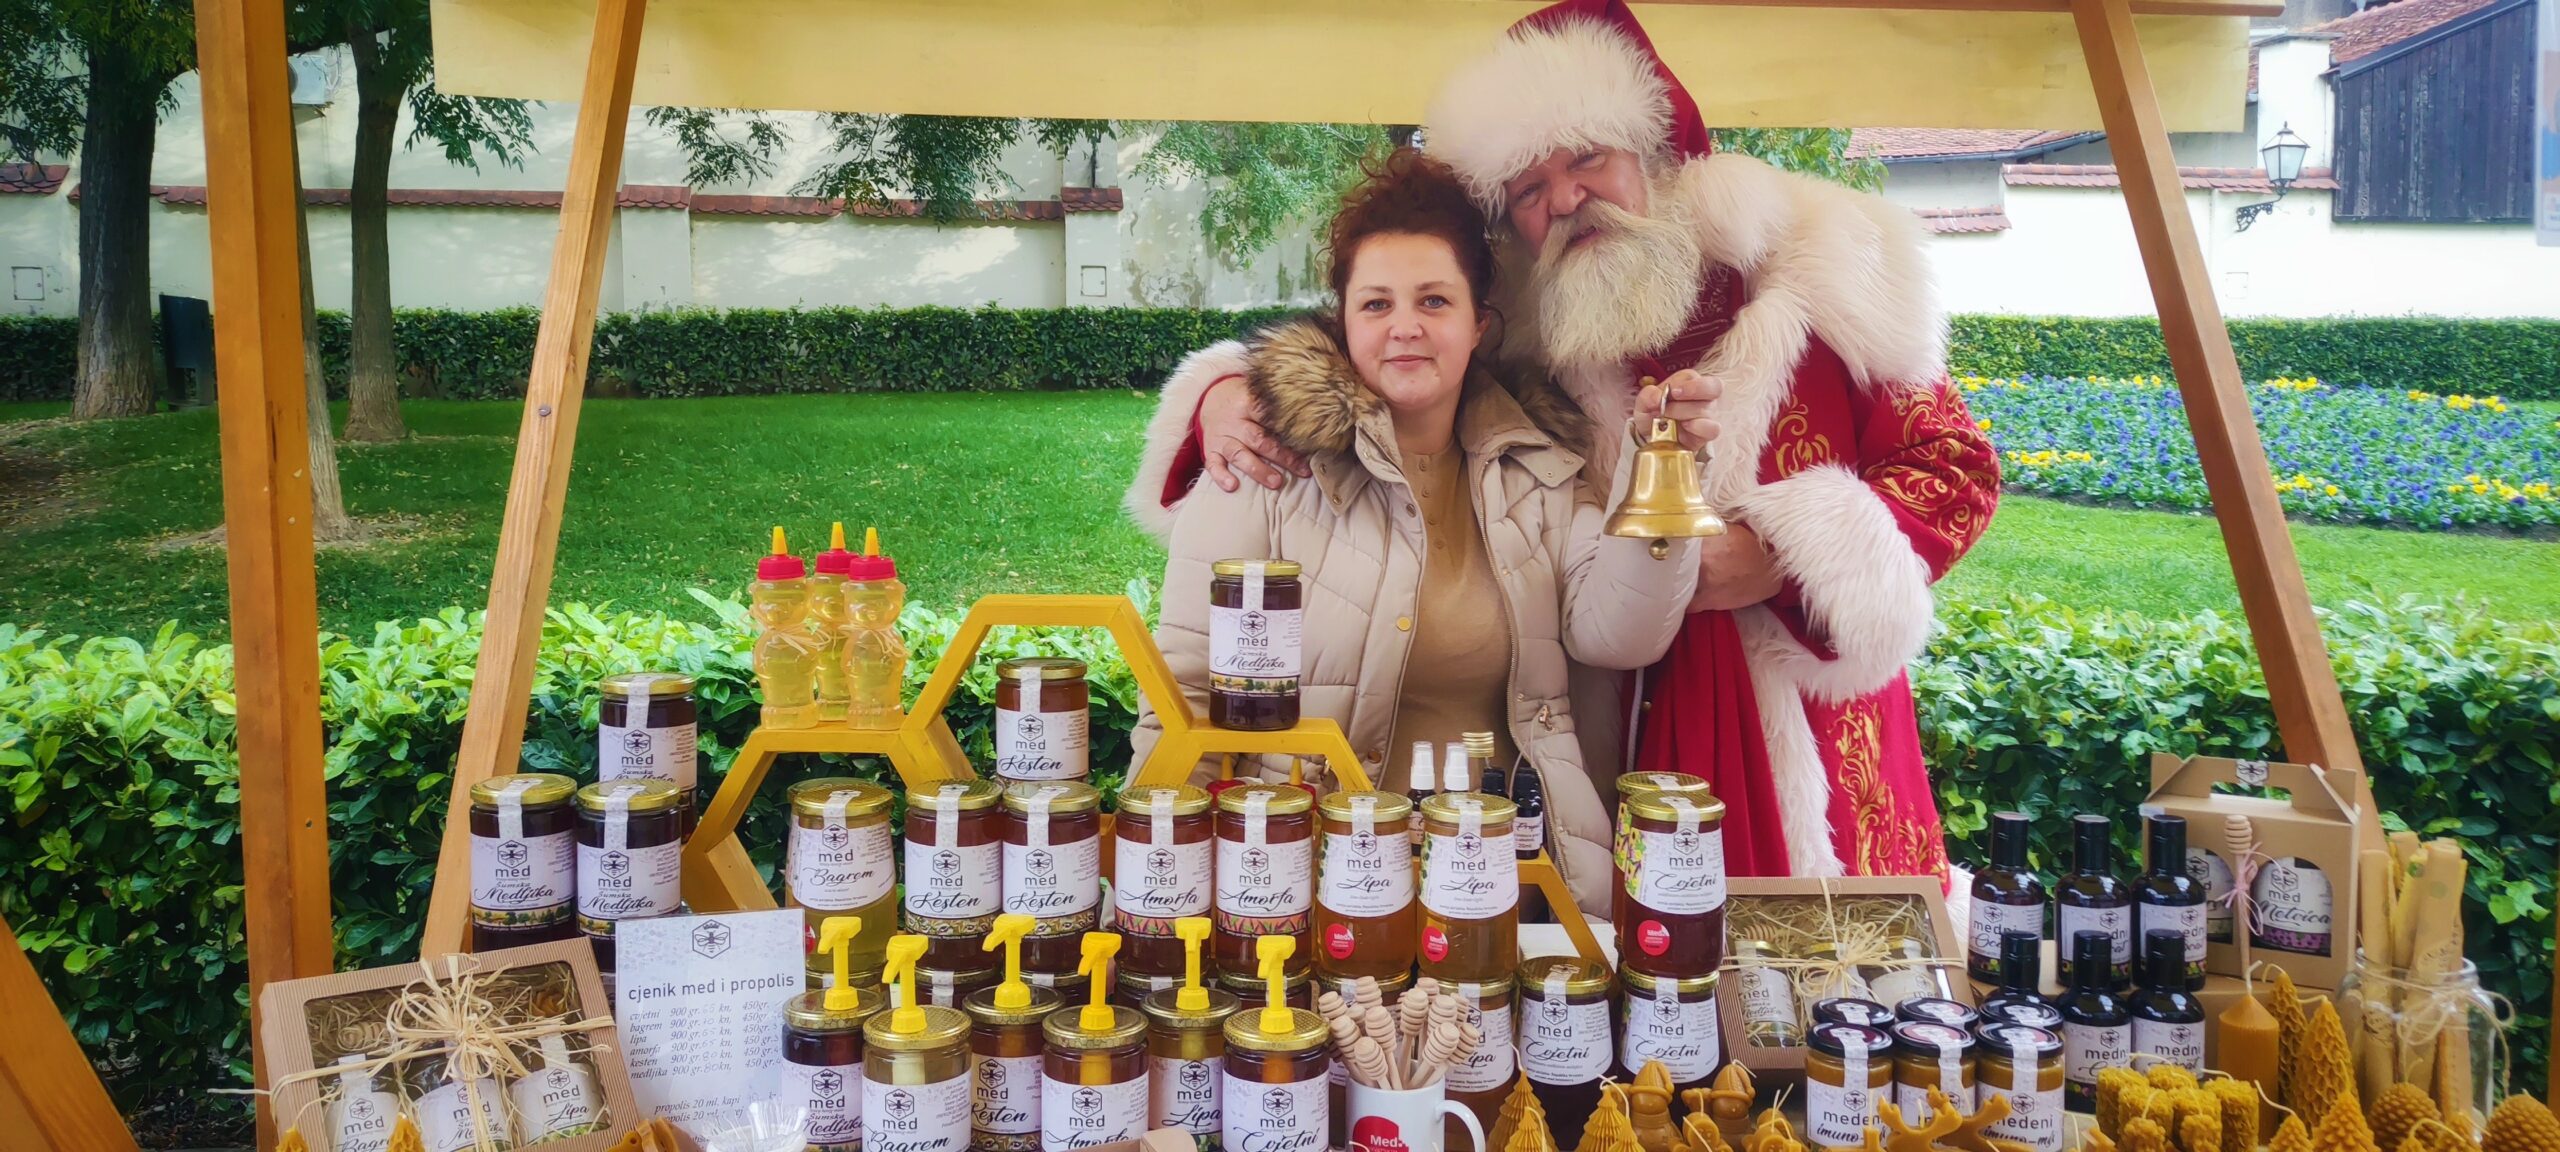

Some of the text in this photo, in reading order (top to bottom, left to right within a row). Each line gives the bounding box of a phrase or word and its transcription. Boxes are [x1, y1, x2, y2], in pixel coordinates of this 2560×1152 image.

[1237, 636, 1268, 647] med
[1016, 739, 1046, 750] med
[621, 754, 654, 765] med
[999, 754, 1064, 775] Kesten
[819, 849, 854, 862] med
[1669, 854, 1703, 867] med
[1347, 857, 1382, 869] med
[1451, 859, 1486, 871] med
[496, 865, 531, 878] med
[802, 867, 873, 887] Bagrem
[598, 876, 632, 888] med
[930, 875, 963, 887] med
[1025, 874, 1057, 887] med
[1144, 874, 1177, 886] med
[1239, 873, 1271, 885] med
[1336, 874, 1392, 893] Lipa
[1440, 877, 1497, 895] Lipa
[474, 885, 556, 904] Medljika
[909, 891, 981, 912] Kesten
[1007, 890, 1077, 912] Kesten
[1119, 886, 1200, 912] Amorfa
[1218, 886, 1296, 911] Amorfa
[2268, 890, 2301, 903] med
[578, 897, 657, 914] Medljika
[629, 974, 794, 1003] cjenik med i propolis
[670, 1006, 687, 1017] 900
[630, 1023, 662, 1034] bagrem
[670, 1018, 687, 1029] 900
[1538, 1025, 1572, 1038] med
[1649, 1024, 1684, 1036] med
[630, 1033, 647, 1046] lipa
[670, 1030, 687, 1041] 900
[671, 1042, 688, 1052] 900
[630, 1057, 658, 1068] kesten
[670, 1054, 687, 1064] 900
[1467, 1051, 1496, 1069] ipa
[630, 1068, 668, 1080] medljika
[672, 1065, 689, 1076] 900
[543, 1084, 581, 1104] med
[977, 1087, 1008, 1100] med
[1177, 1086, 1212, 1100] med
[654, 1099, 690, 1114] propolis
[692, 1098, 704, 1108] 20
[721, 1096, 741, 1108] kapi
[810, 1095, 845, 1109] med
[453, 1100, 492, 1120] md
[664, 1109, 690, 1122] opolis
[692, 1109, 704, 1120] 20
[1162, 1104, 1222, 1128] Lipa
[882, 1117, 917, 1130] med
[1070, 1115, 1105, 1128] med
[1260, 1115, 1296, 1128] med
[1824, 1111, 1880, 1126] meden
[344, 1116, 385, 1136] med
